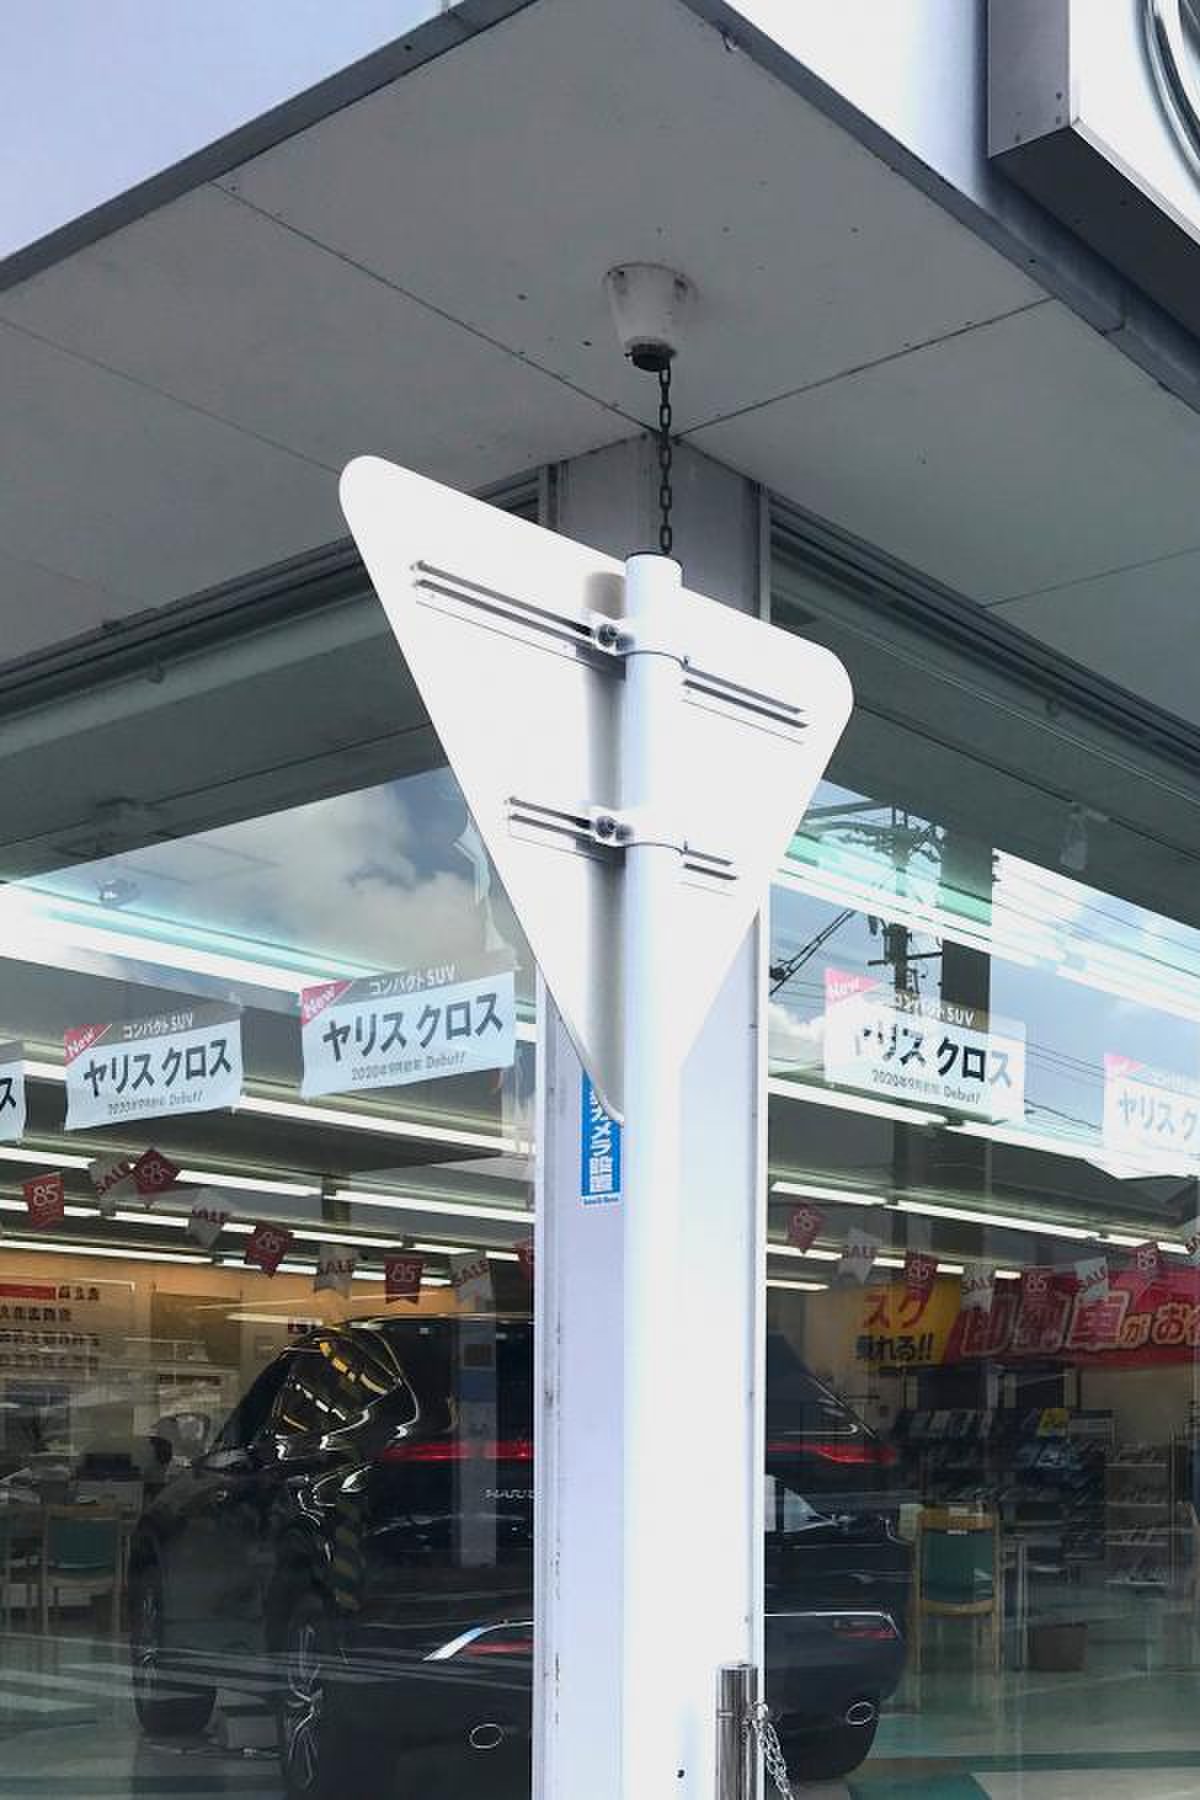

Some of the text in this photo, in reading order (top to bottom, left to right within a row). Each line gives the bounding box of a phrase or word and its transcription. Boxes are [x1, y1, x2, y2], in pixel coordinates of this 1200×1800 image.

[304, 986, 337, 1015] New
[65, 1028, 96, 1058] New
[323, 992, 504, 1062] ヤリスクロス
[84, 1039, 232, 1098] ヤリスクロス
